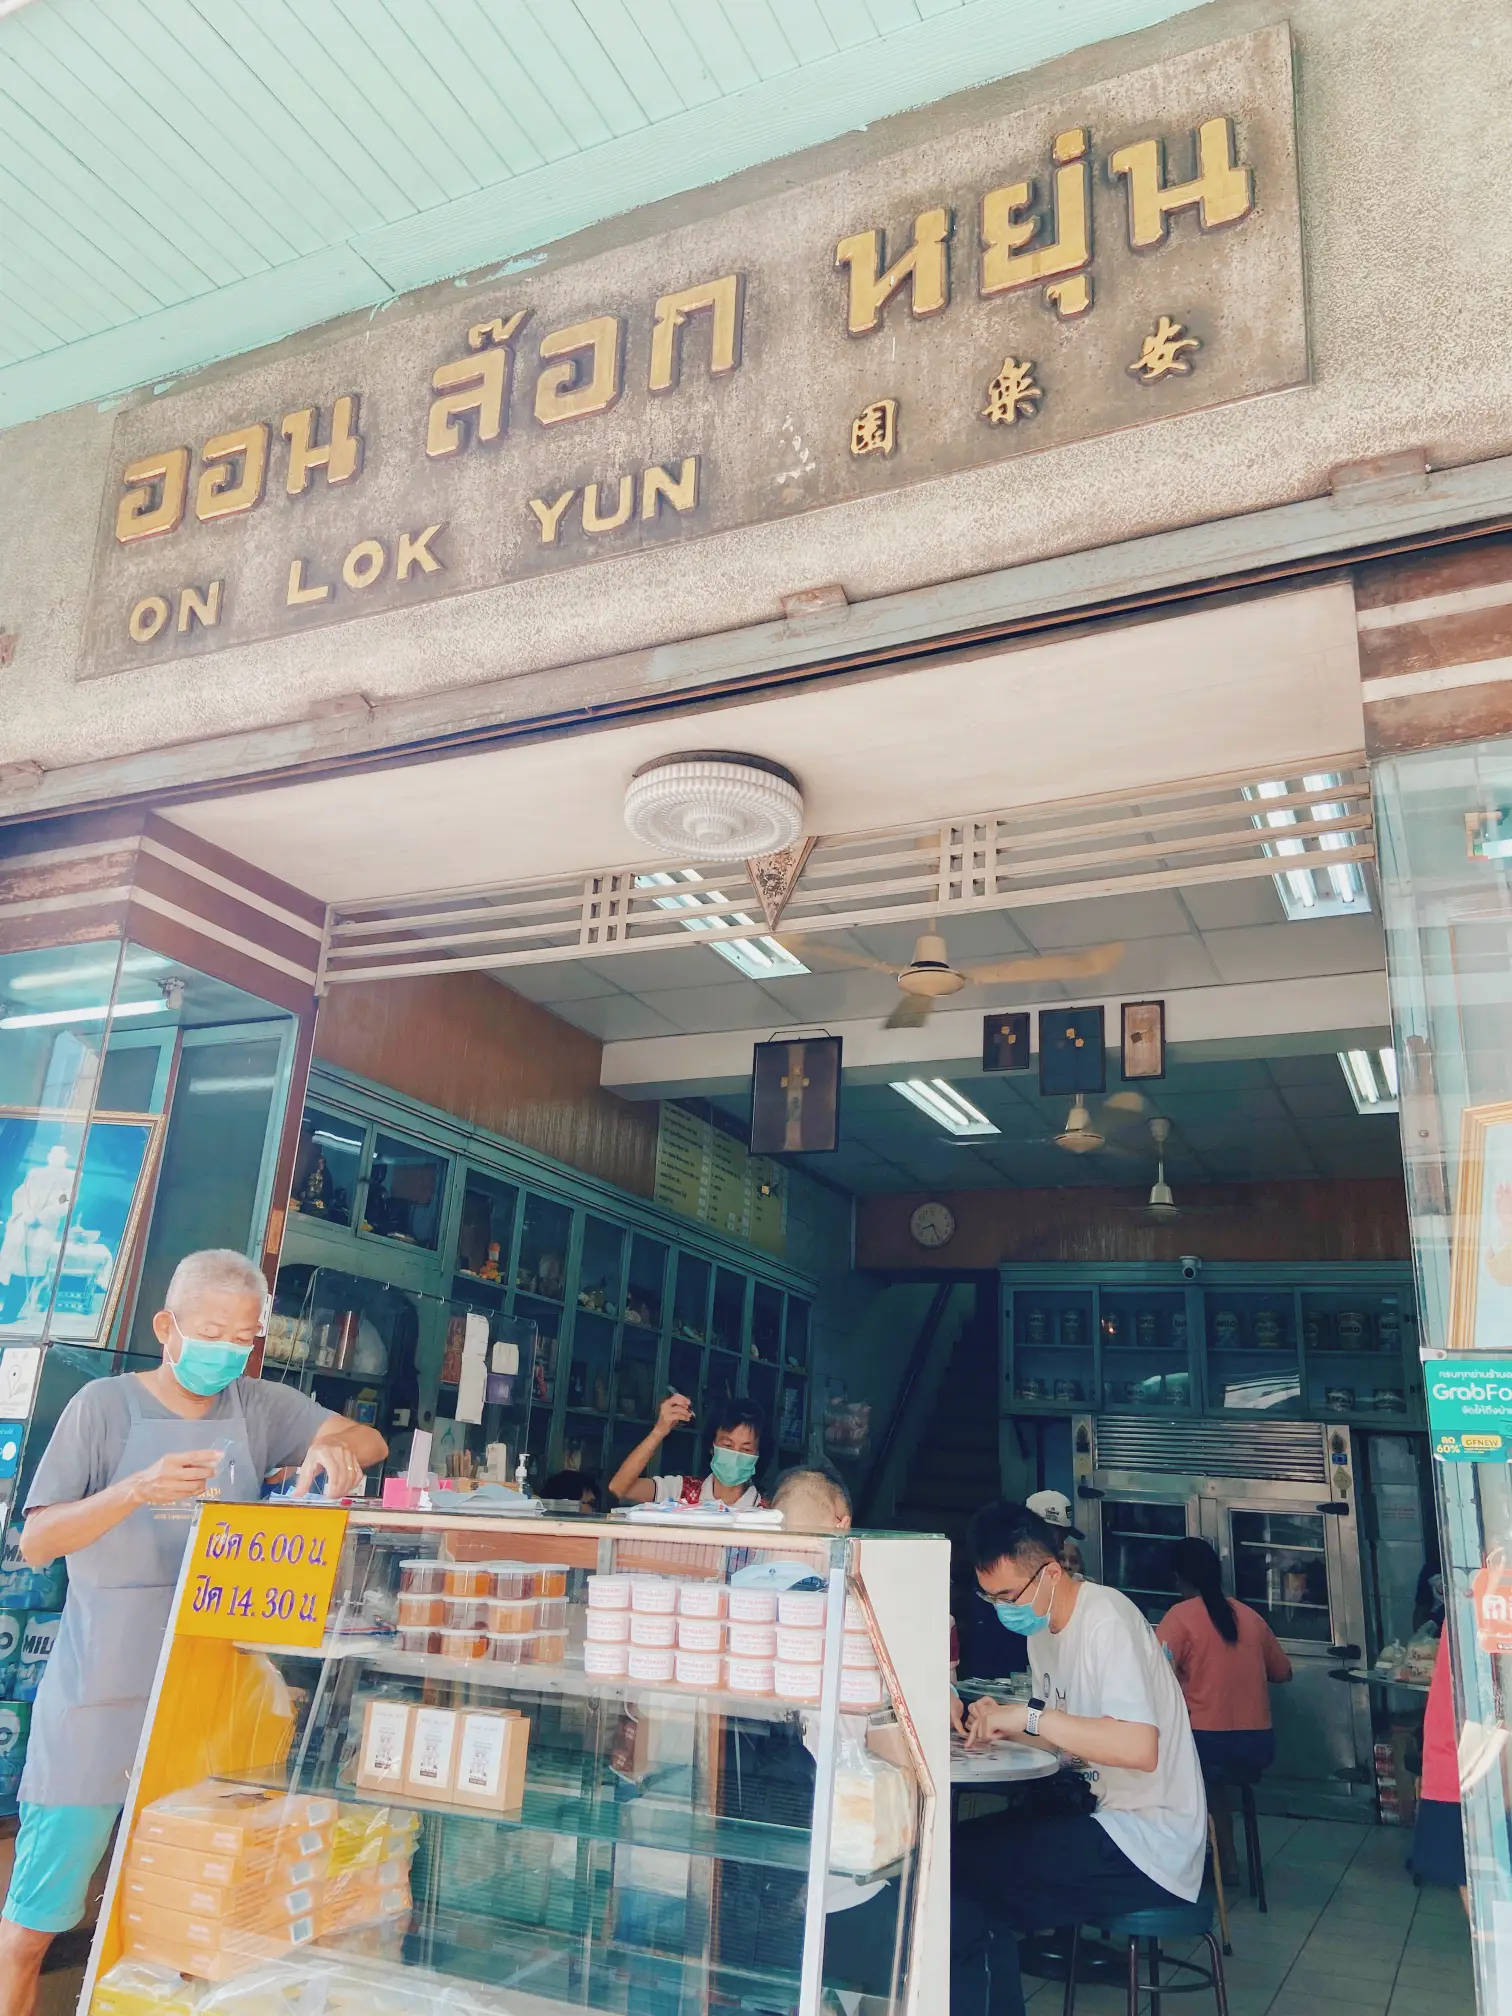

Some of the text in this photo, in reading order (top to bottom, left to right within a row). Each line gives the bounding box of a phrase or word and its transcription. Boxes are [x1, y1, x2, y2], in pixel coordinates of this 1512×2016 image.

[116, 393, 362, 543] ออน
[128, 456, 698, 645] ON LOK YUN
[1432, 1382, 1512, 1401] GrabFo
[1465, 1439, 1498, 1447] GFNEW
[206, 1521, 244, 1561] เปิด
[248, 1531, 305, 1564] 6.00
[192, 1574, 224, 1614] ปิด
